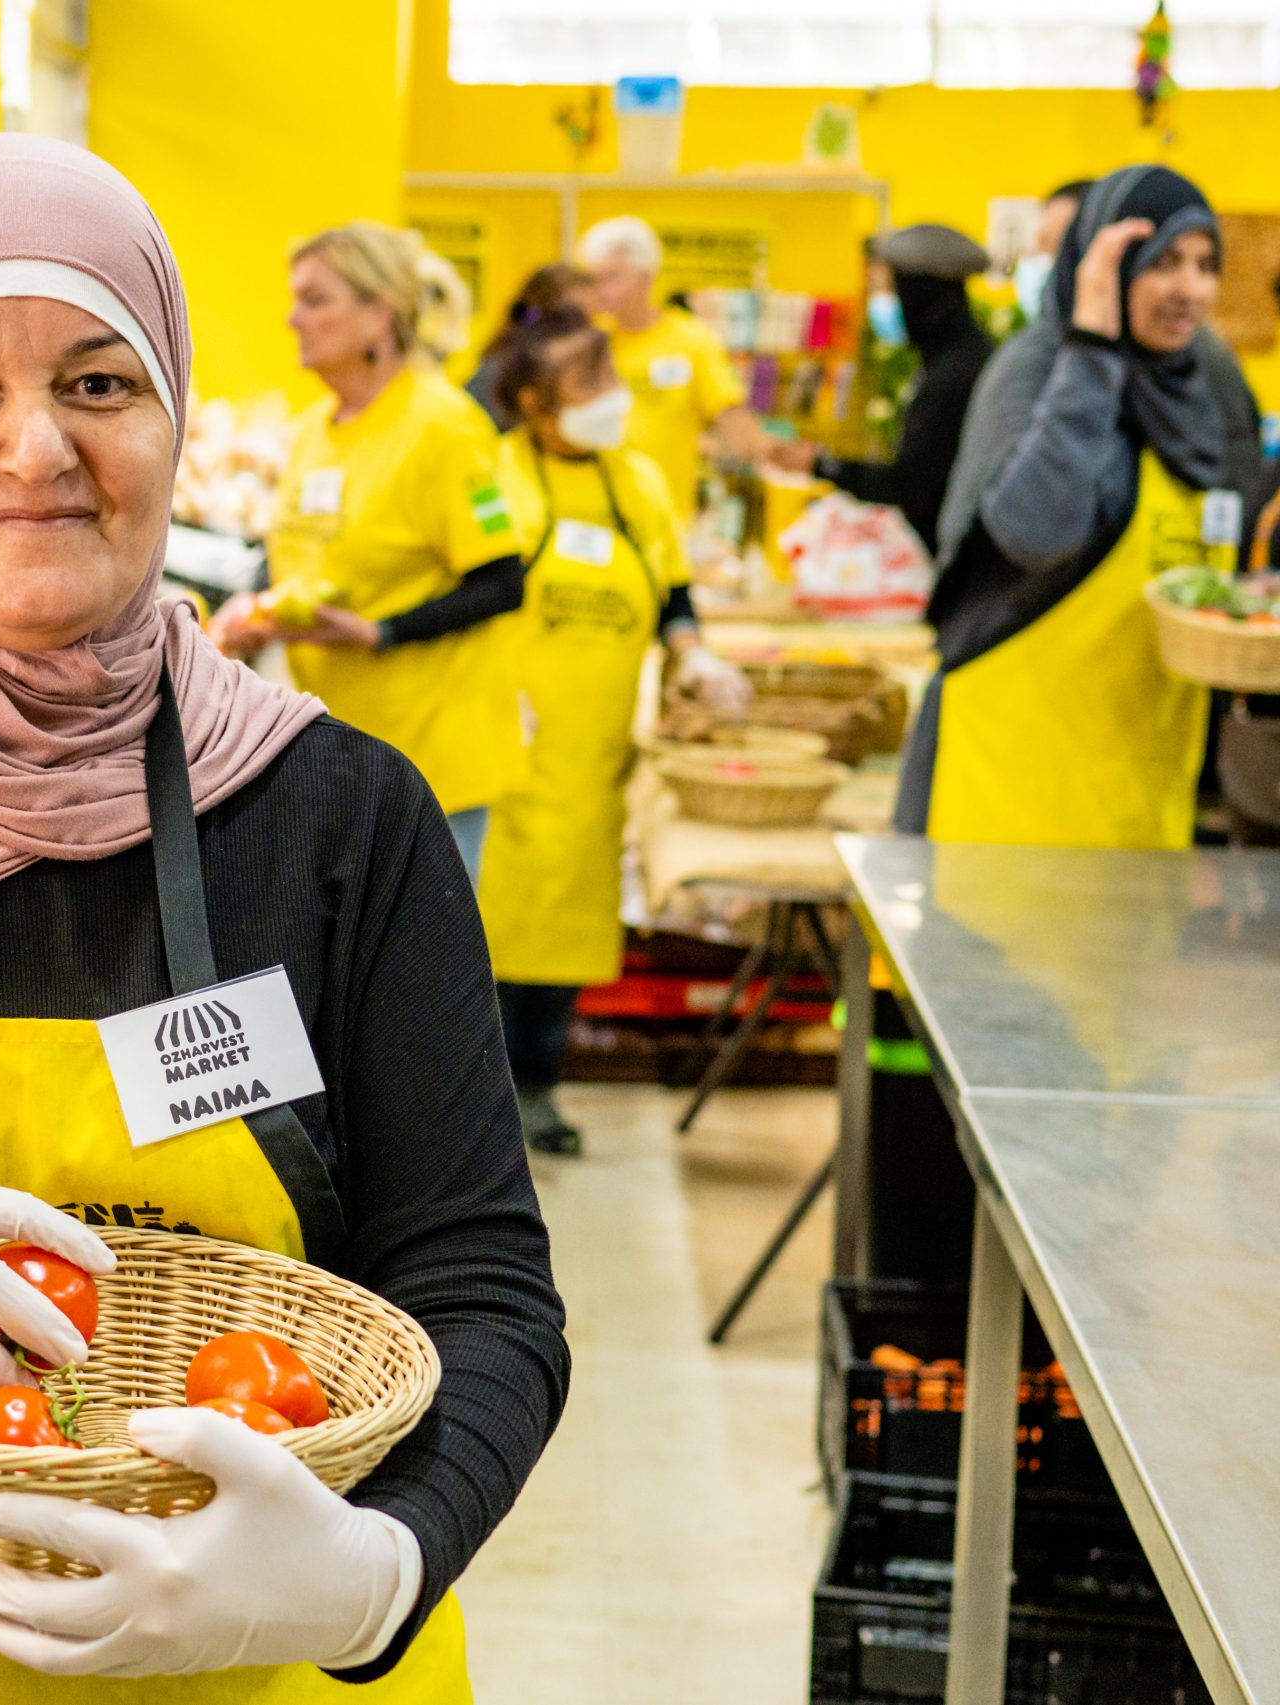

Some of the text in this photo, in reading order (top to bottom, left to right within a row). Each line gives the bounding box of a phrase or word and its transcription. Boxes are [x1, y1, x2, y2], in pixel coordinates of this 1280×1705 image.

[160, 1032, 245, 1066] OZHARVEST
[165, 1045, 250, 1084] MARKET
[169, 1079, 271, 1125] NAIMA
